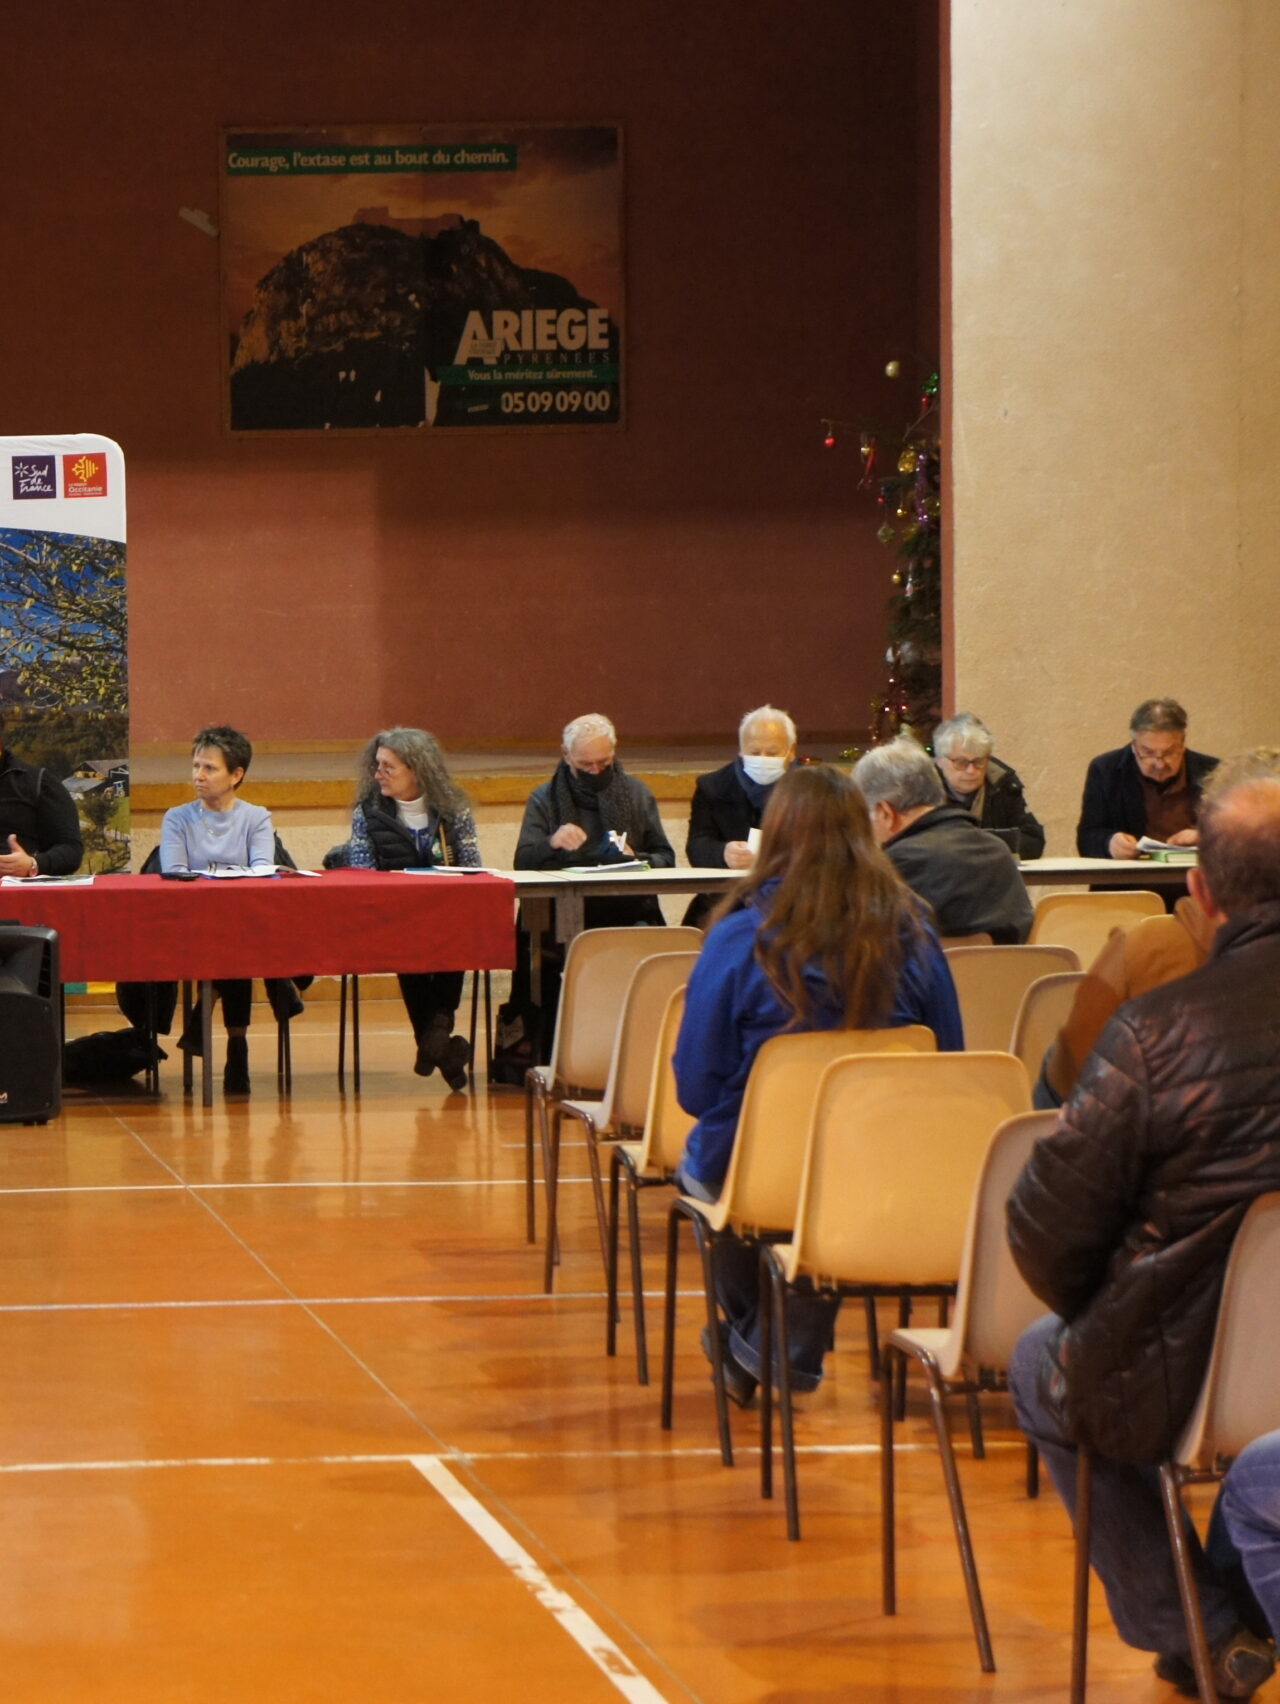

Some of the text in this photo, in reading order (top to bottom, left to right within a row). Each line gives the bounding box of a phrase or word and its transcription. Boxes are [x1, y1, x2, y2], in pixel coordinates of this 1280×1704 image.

[228, 148, 510, 172] Courage, l'extase est au bout du chemin.
[453, 308, 610, 366] ARIEGE
[467, 369, 491, 381] Vous
[493, 369, 503, 380] la
[28, 464, 48, 477] Sud
[19, 478, 54, 494] France
